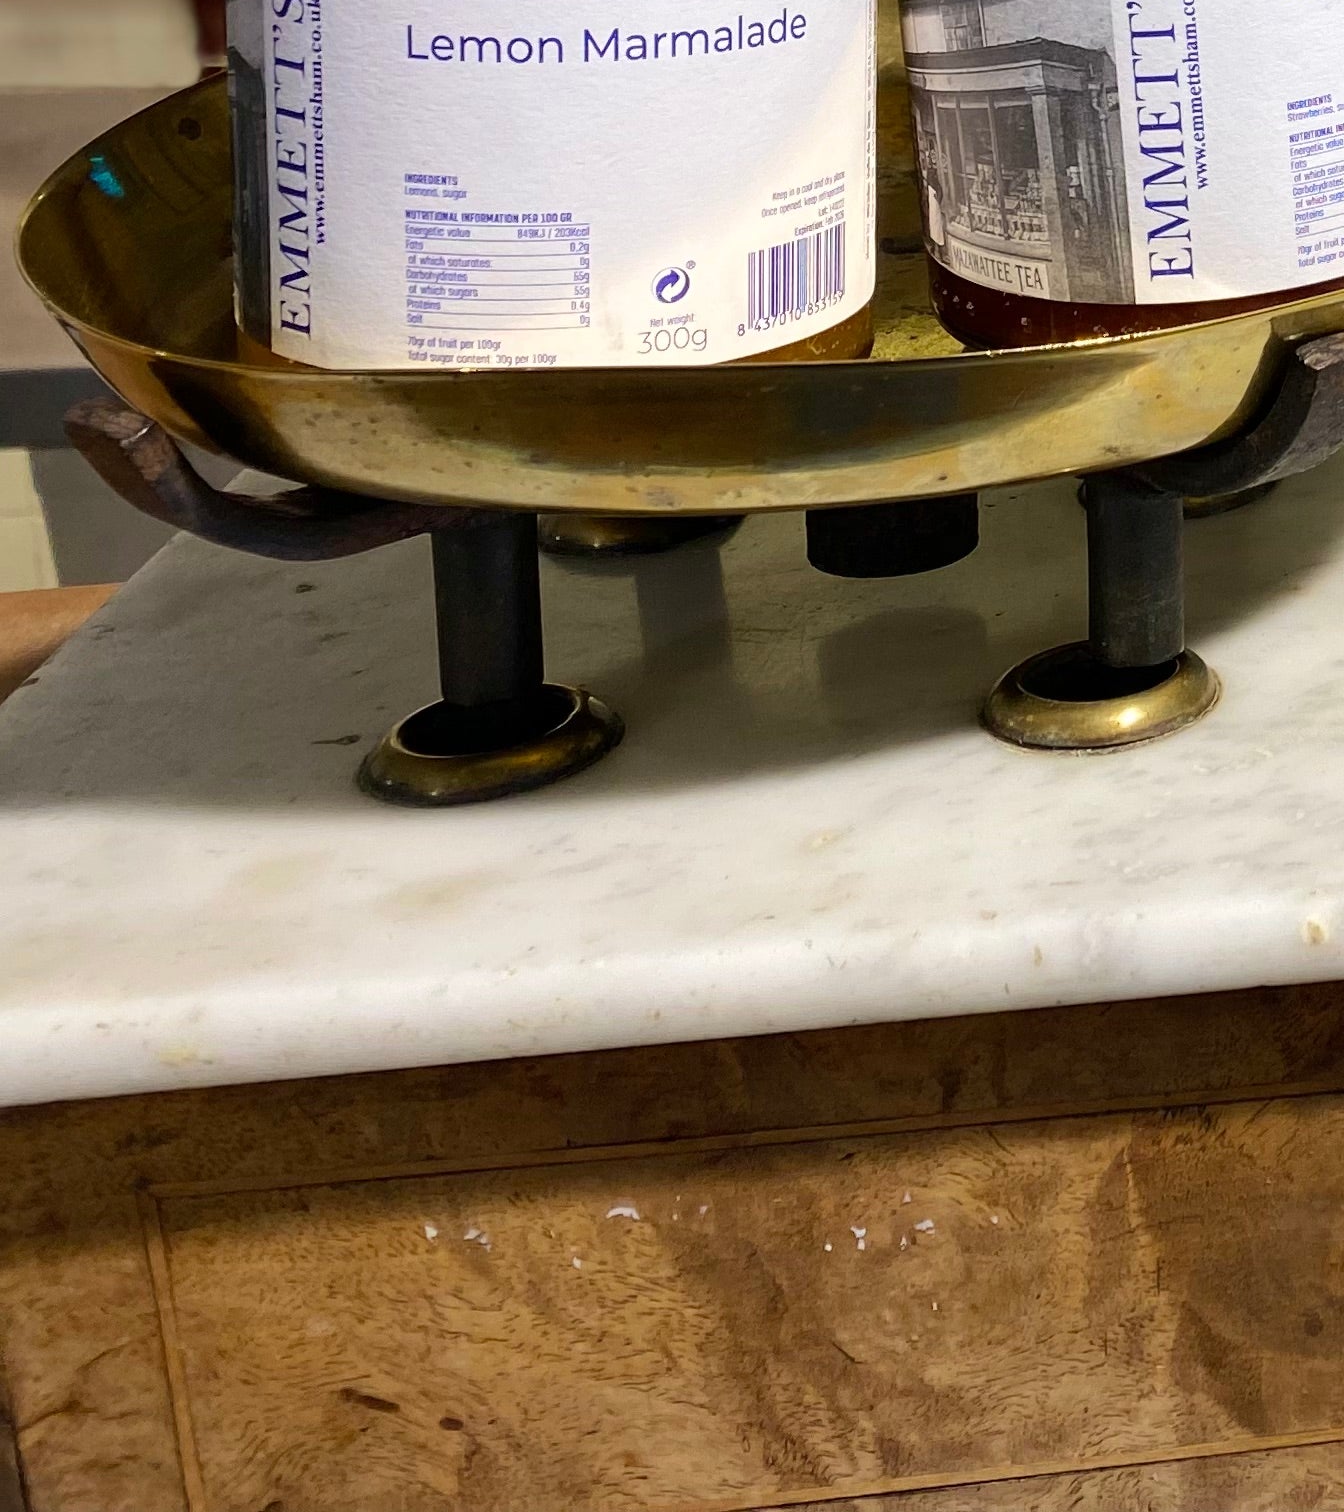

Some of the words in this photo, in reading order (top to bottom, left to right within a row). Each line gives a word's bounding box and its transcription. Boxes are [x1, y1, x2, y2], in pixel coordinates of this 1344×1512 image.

[406, 24, 563, 64] Lemon
[583, 7, 807, 62] Marmalade
[404, 173, 458, 186] INGREDIENTS
[405, 209, 458, 222] NUTRITIONAL
[461, 211, 519, 223] INFORMATION
[522, 213, 538, 223] PER
[541, 213, 557, 223] 100
[560, 213, 572, 223] GR
[1014, 264, 1044, 293] TEA
[637, 326, 708, 354] 300g
[737, 323, 746, 337] 8
